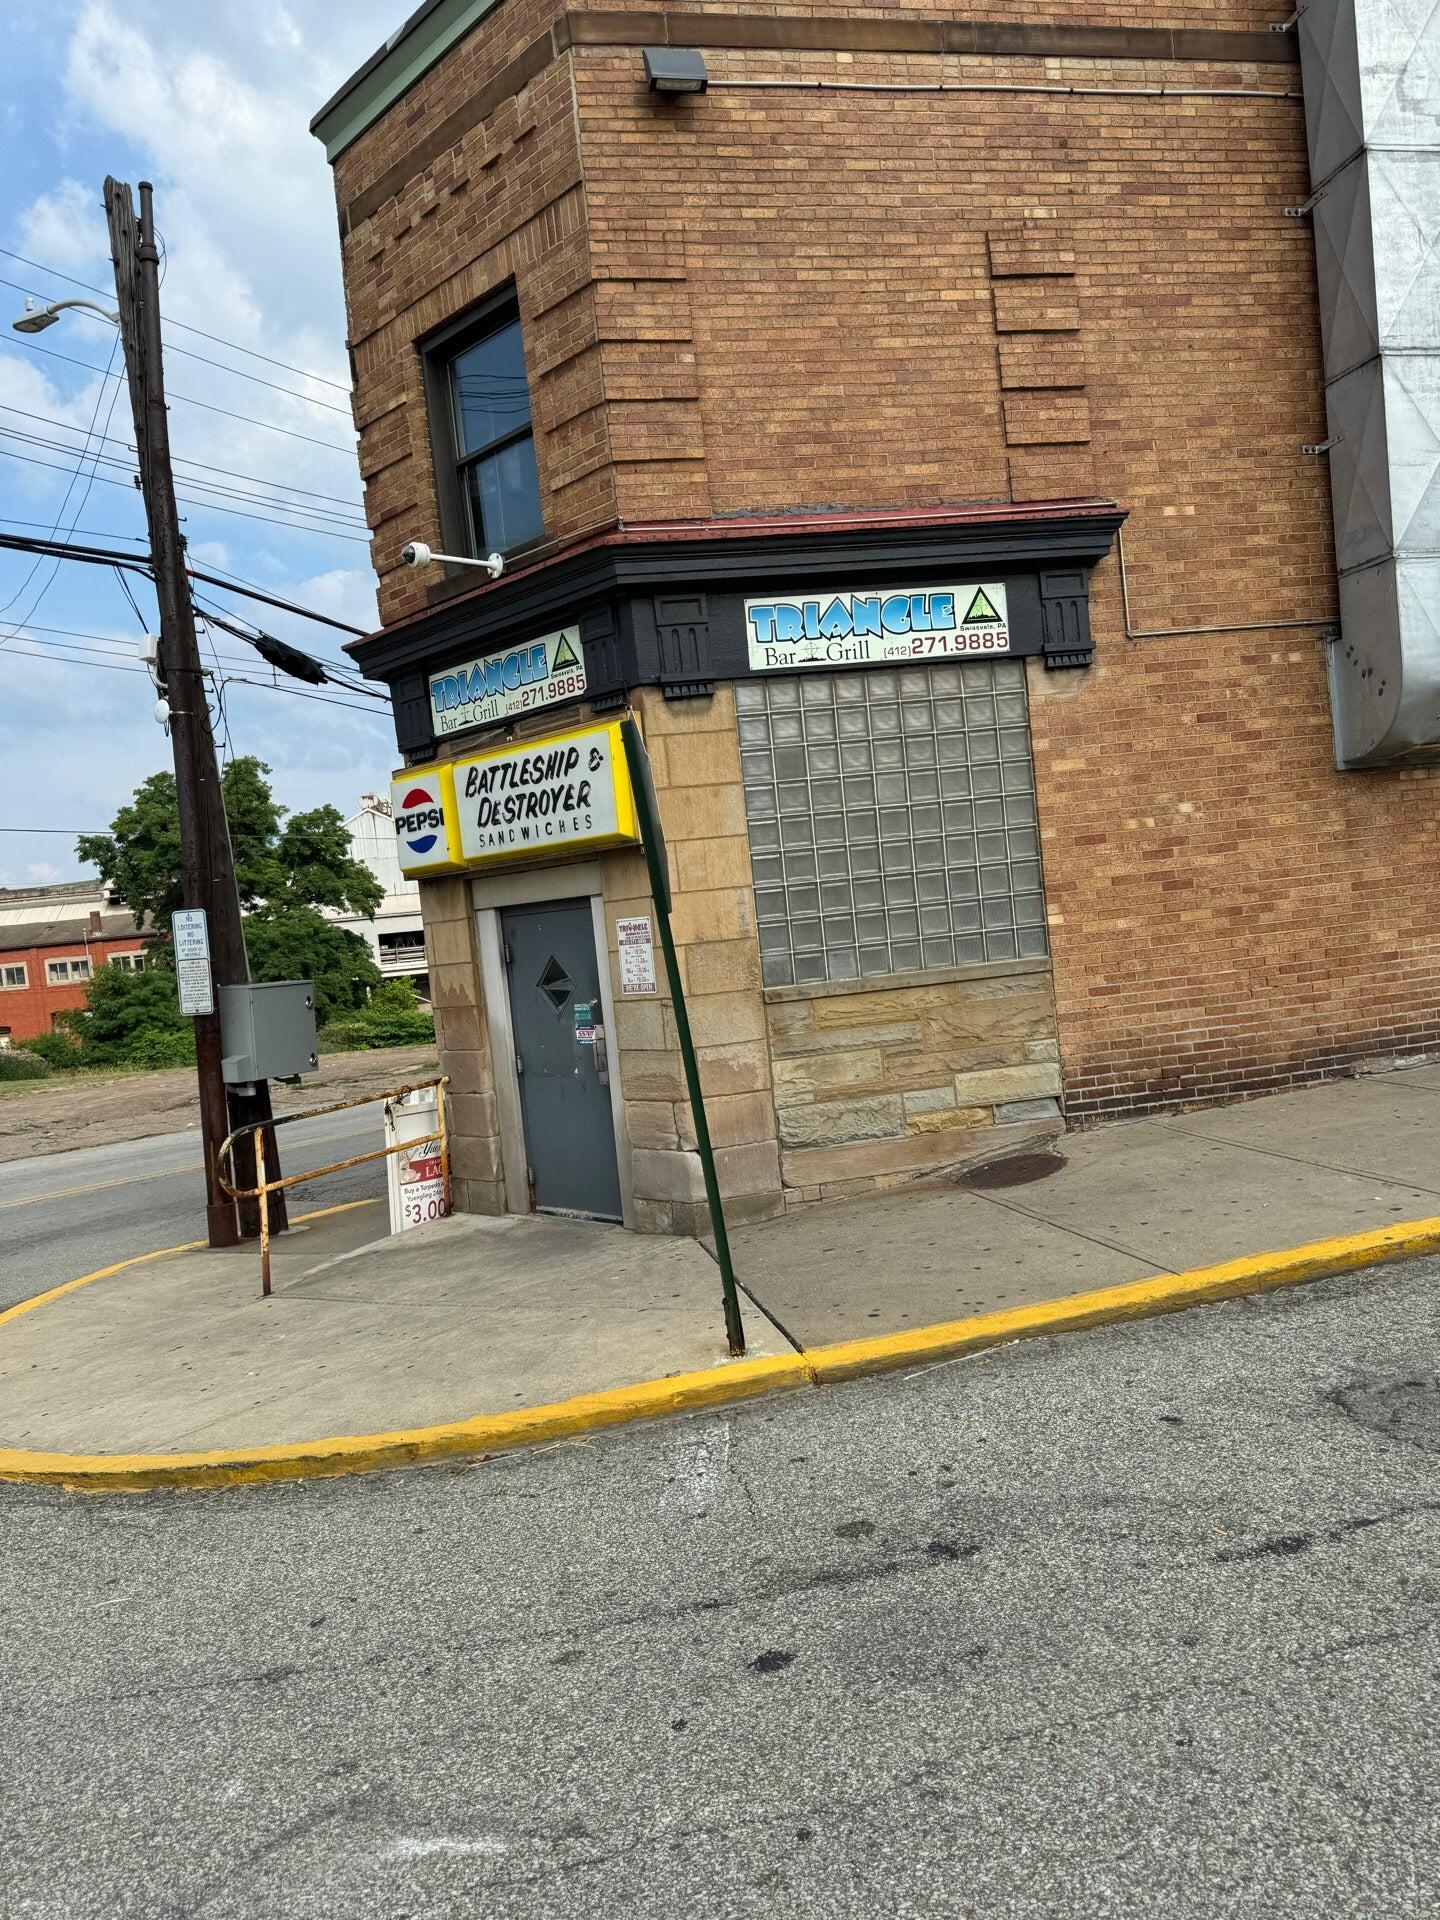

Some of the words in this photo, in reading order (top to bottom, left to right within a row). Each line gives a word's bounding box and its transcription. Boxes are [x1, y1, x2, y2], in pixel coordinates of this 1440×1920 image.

[749, 593, 956, 644] TRIANGLE
[997, 622, 1007, 630] PA
[765, 646, 797, 666] Bar
[826, 641, 870, 662] Grill
[430, 643, 549, 713] TRIANGLE
[440, 715, 458, 732] Bar
[473, 699, 499, 722] Grill
[465, 747, 580, 798] BATTLESHIP
[588, 747, 604, 772] &
[477, 780, 591, 828] DESTROYER
[395, 807, 445, 835] PEPSI
[479, 814, 593, 847] SANDWICHES
[177, 923, 203, 931] LOITERING
[179, 938, 204, 946] LITTERING
[407, 1192, 432, 1201] Yuengling
[421, 1181, 440, 1190] Torpedo
[405, 1198, 446, 1223] $3.00
